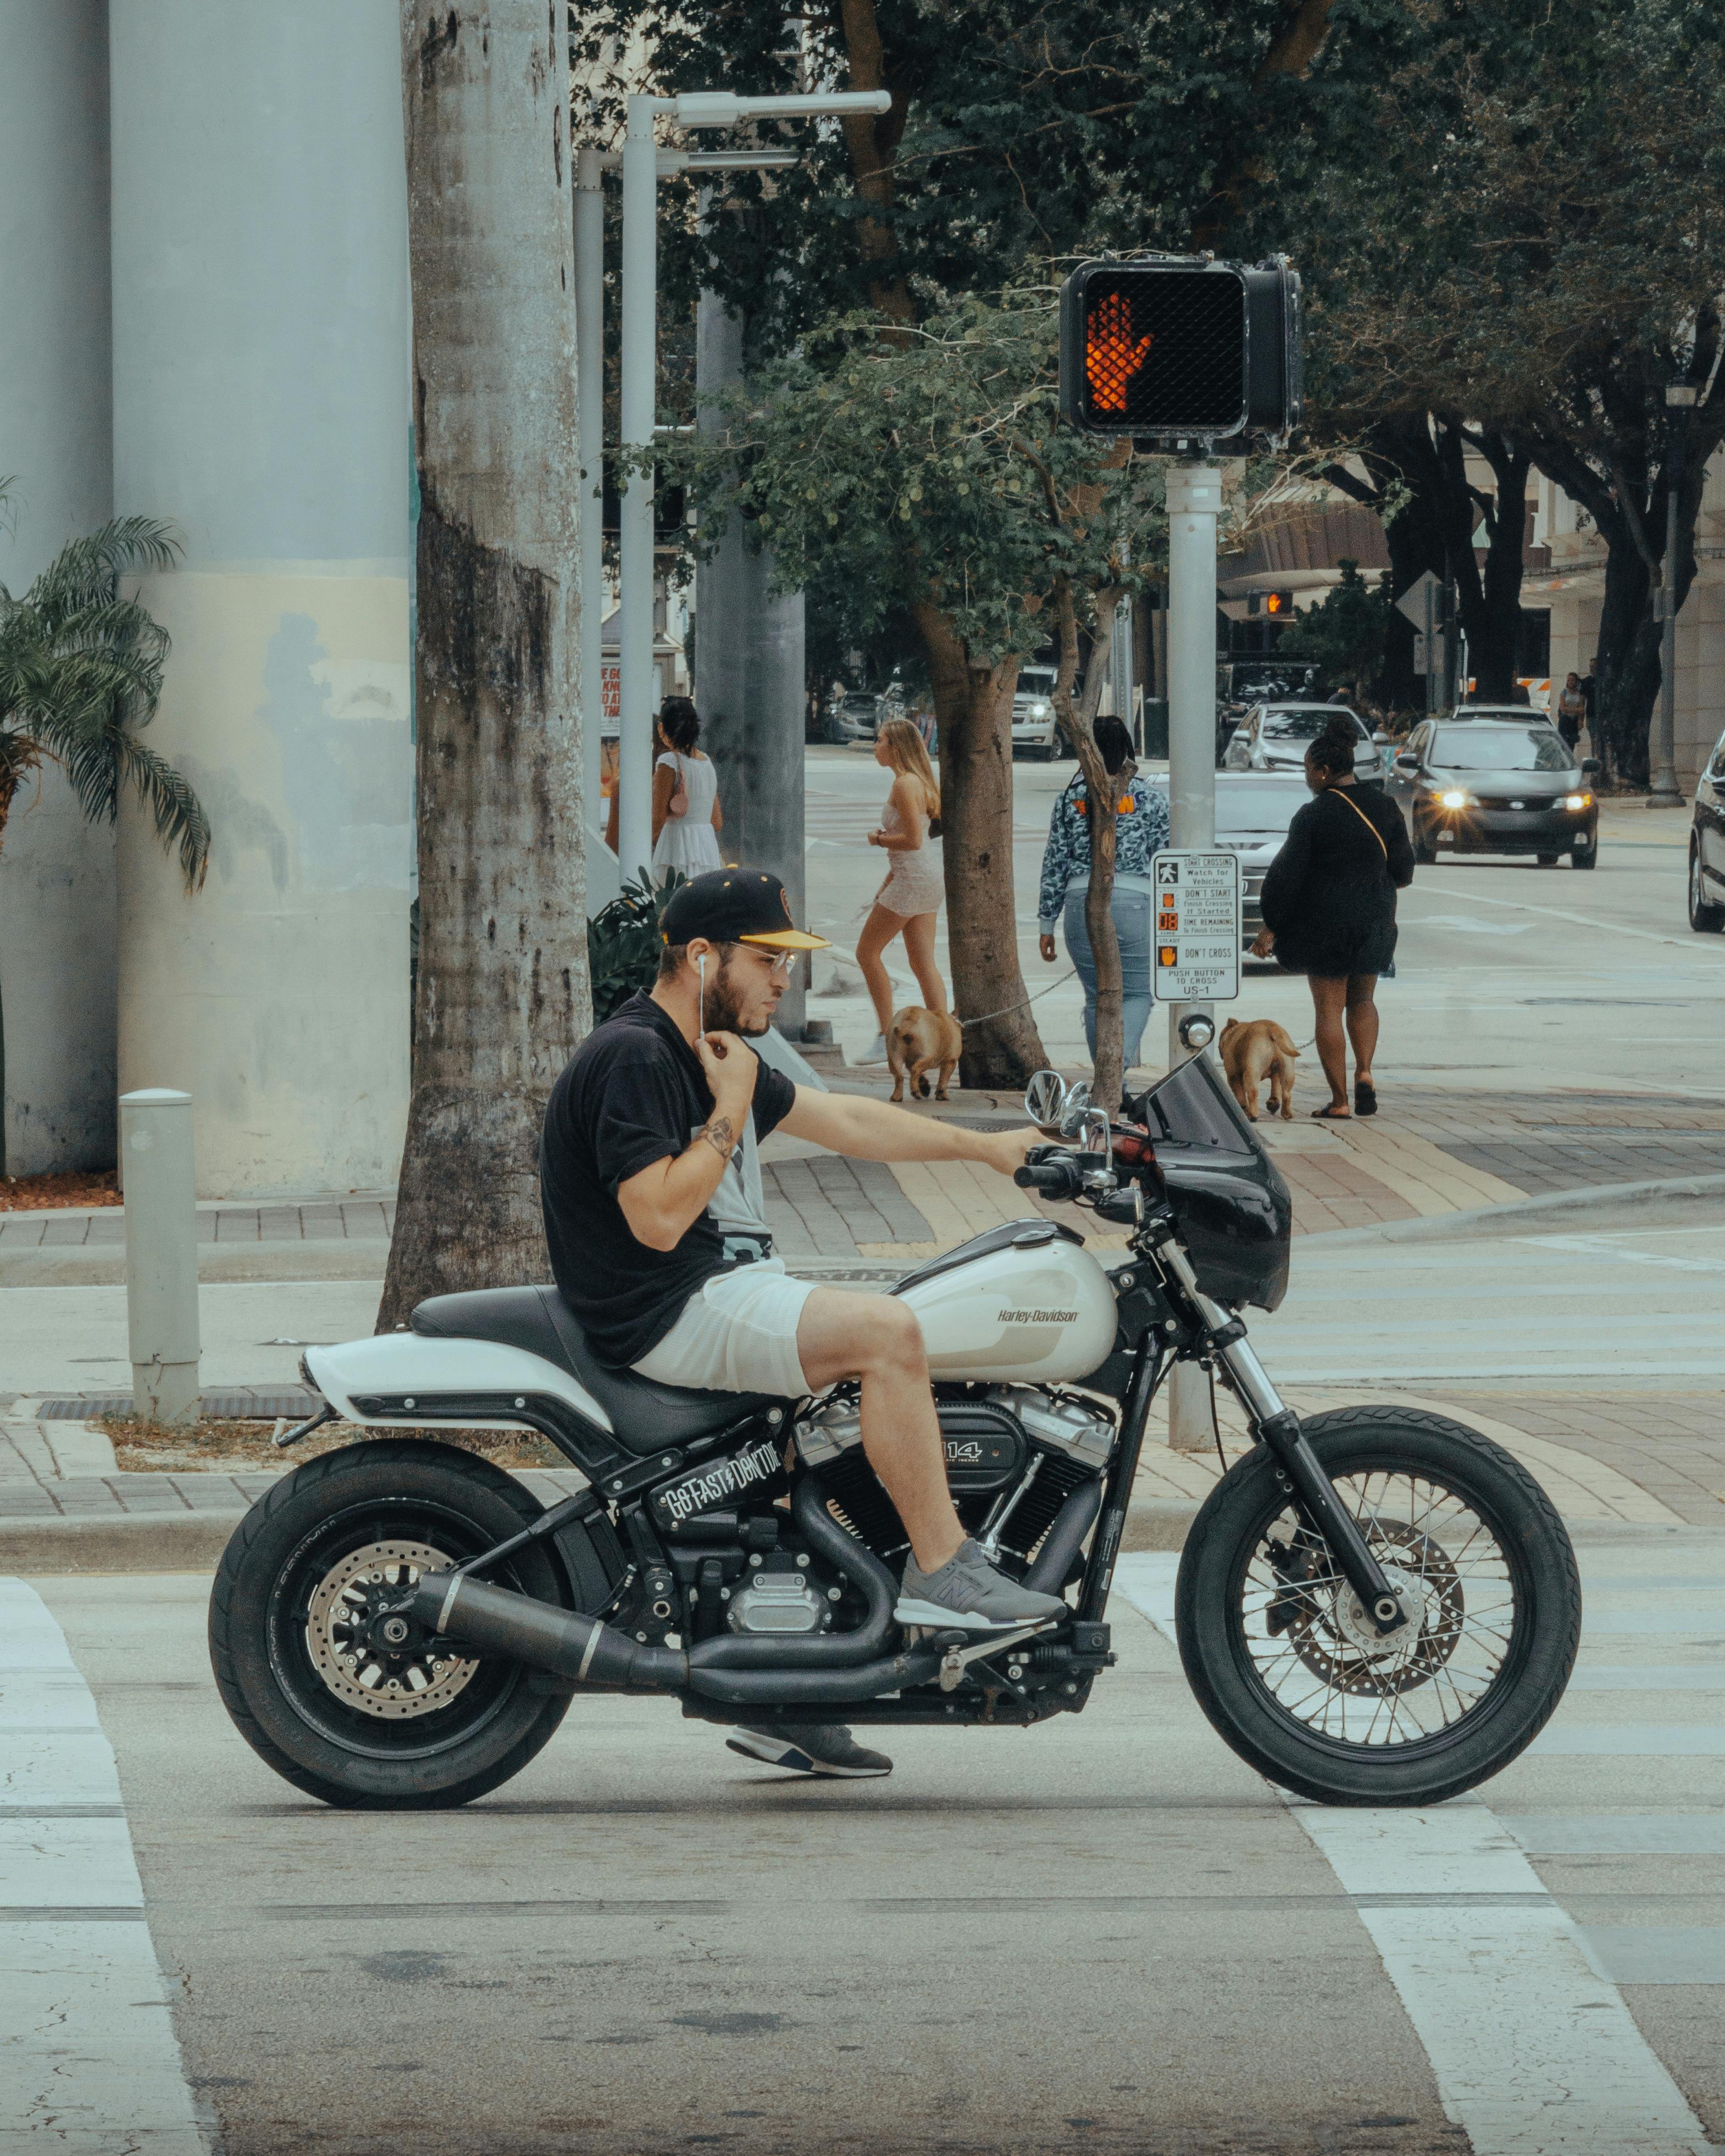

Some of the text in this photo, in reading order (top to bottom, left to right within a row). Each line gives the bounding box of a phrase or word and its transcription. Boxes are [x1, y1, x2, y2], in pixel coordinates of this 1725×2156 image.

[1184, 858, 1233, 866] START CROSSING
[1185, 889, 1231, 897] DON'T START
[1159, 914, 1178, 930] 08
[1185, 948, 1232, 958] DON'T CROSS
[1184, 986, 1209, 994] US-1
[997, 1309, 1078, 1324] Harley-Davidson
